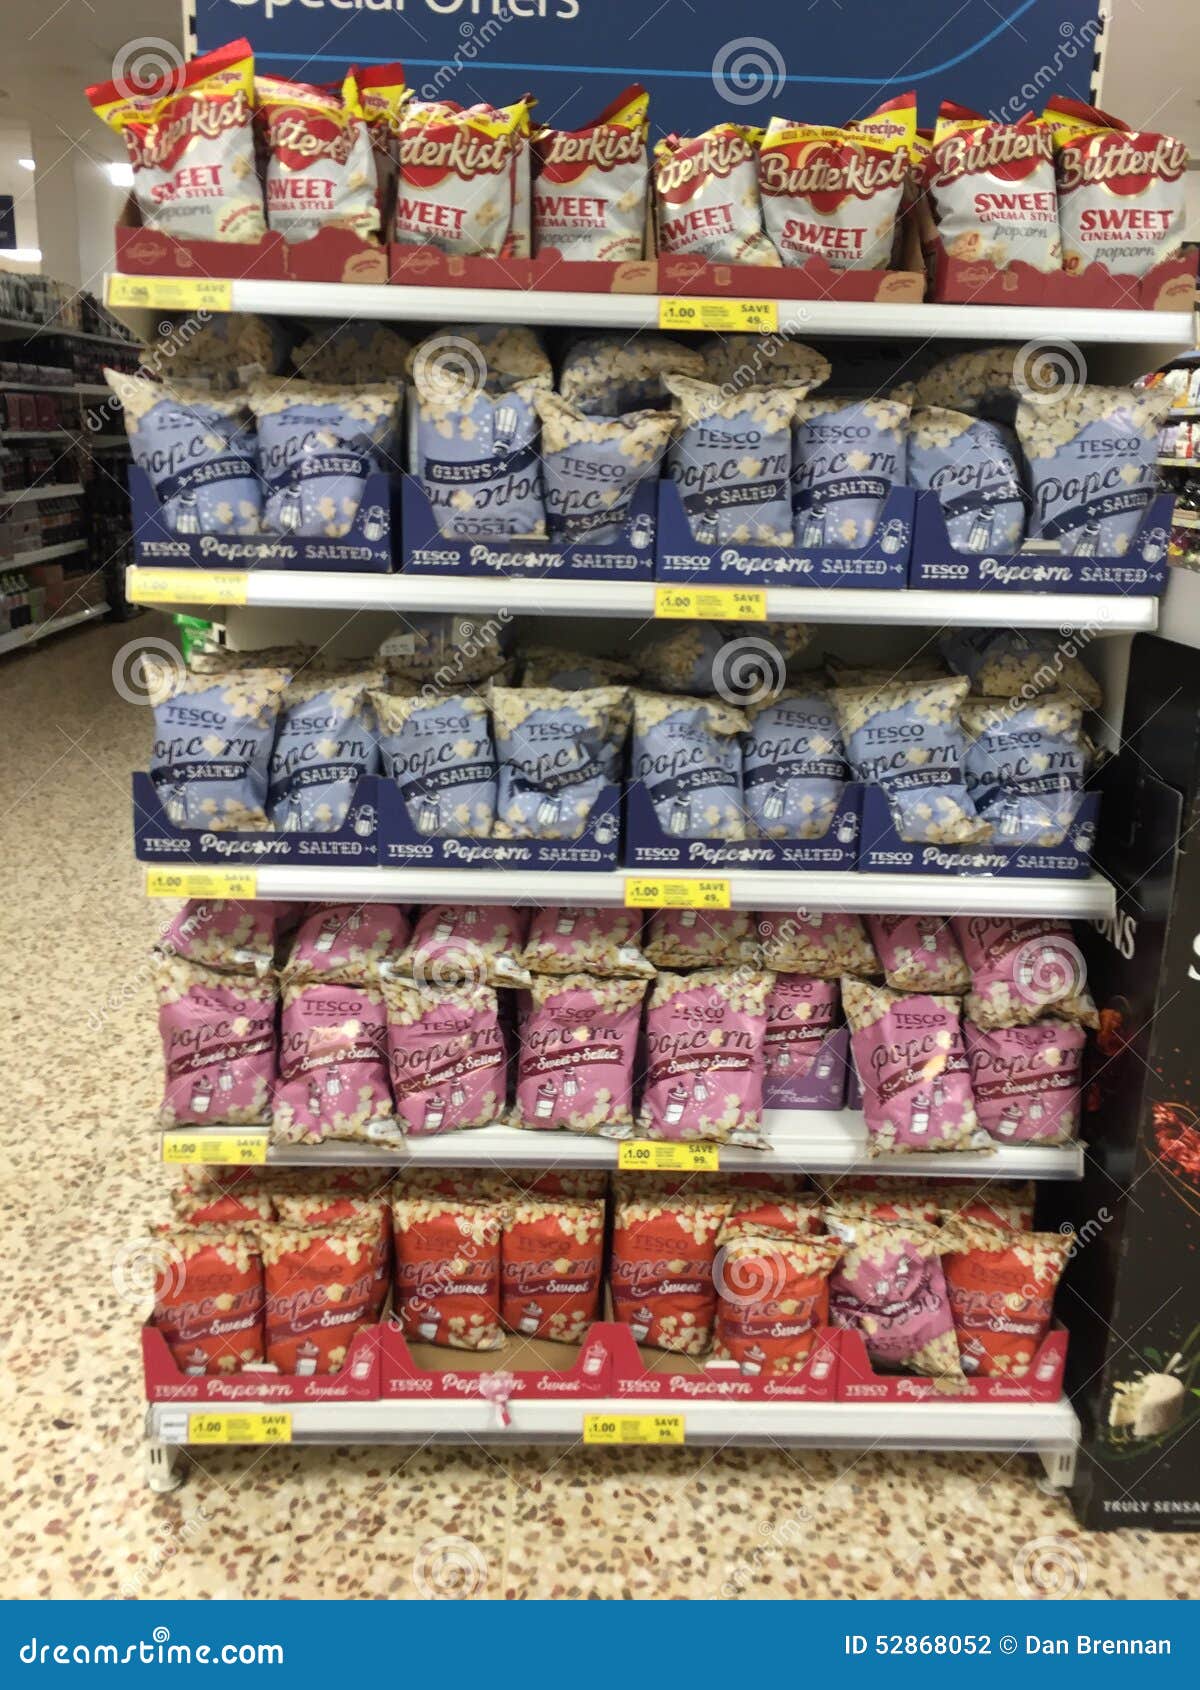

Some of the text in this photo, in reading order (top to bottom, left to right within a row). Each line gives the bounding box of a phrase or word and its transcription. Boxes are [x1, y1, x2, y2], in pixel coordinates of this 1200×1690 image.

[228, 0, 400, 19] pial
[863, 119, 906, 138] recipe
[399, 132, 508, 175] tterkist
[545, 126, 642, 172] terkist
[930, 127, 1053, 184] Butterki
[759, 145, 909, 195] Butterkist
[1060, 138, 1190, 189] Butterki
[267, 178, 337, 200] WEET
[399, 199, 467, 229] WEET
[535, 198, 608, 217] WEET
[979, 212, 1025, 223] CINEMA
[1080, 209, 1174, 231] SWEET
[782, 219, 867, 249] SWEET
[993, 225, 1048, 240] popcorn
[1081, 231, 1131, 242] CINEMA
[781, 239, 864, 259] CINEMA STYLE
[1096, 246, 1157, 262] popcorn
[741, 304, 770, 313] SAVE
[698, 428, 761, 445] TESCO
[807, 425, 871, 439] TESCO
[1078, 438, 1141, 452] TESCO
[193, 461, 252, 481] SALTED
[301, 459, 362, 475] SALTED
[432, 463, 493, 481] SALTED
[561, 456, 627, 477] TESCO
[720, 485, 777, 504] SALTED
[828, 481, 885, 498] SALTED
[142, 536, 371, 560] TESCO Popcorn SALTED
[413, 545, 637, 569] TESCO Popcorn SALTED
[664, 550, 887, 575] TESCO Popcorn SALTED
[921, 558, 1147, 584] TESCO Popcorn SALTED
[733, 593, 760, 603] SAVE
[167, 706, 228, 725] TESCO
[284, 715, 339, 731] ESCO
[774, 709, 831, 727] TESCO
[529, 723, 585, 736] TESCO
[865, 724, 925, 739] TESCO
[155, 735, 258, 764] opcorn
[986, 732, 1042, 749] TESCO
[271, 738, 370, 774] opcorn
[301, 766, 358, 785] SALTED
[439, 766, 493, 786] SALTED
[790, 762, 844, 776] SALTED
[895, 771, 952, 789] SALTED
[143, 833, 362, 857] TESCO Popcorn SALTED
[388, 839, 601, 862] TESCO Popcorn SALTED
[636, 842, 843, 864] TESCO Popcorn SALTED
[870, 847, 1079, 870] TESCO Popcorn SALTED
[699, 882, 726, 892] SAVE
[304, 1000, 363, 1012] TESCO
[893, 1012, 947, 1025] TESCO
[526, 1026, 623, 1054] opcorn
[465, 1052, 502, 1070] Salted
[582, 1048, 619, 1062] Salted
[688, 1145, 714, 1154] SAVE
[635, 1235, 688, 1250] TESCO
[445, 1280, 487, 1295] Sweet
[547, 1280, 589, 1293] Sweet
[659, 1280, 702, 1295] Sweet
[209, 1316, 256, 1335] Sweet
[321, 1306, 364, 1327] Sweet
[207, 1380, 293, 1398] Popcorn
[304, 1381, 348, 1396] Sweet
[619, 1375, 807, 1395] TESCO Popcorn Sweet
[261, 1415, 287, 1424] SAVE
[655, 1418, 680, 1427] SAVE
[1103, 1501, 1149, 1513] TRULY
